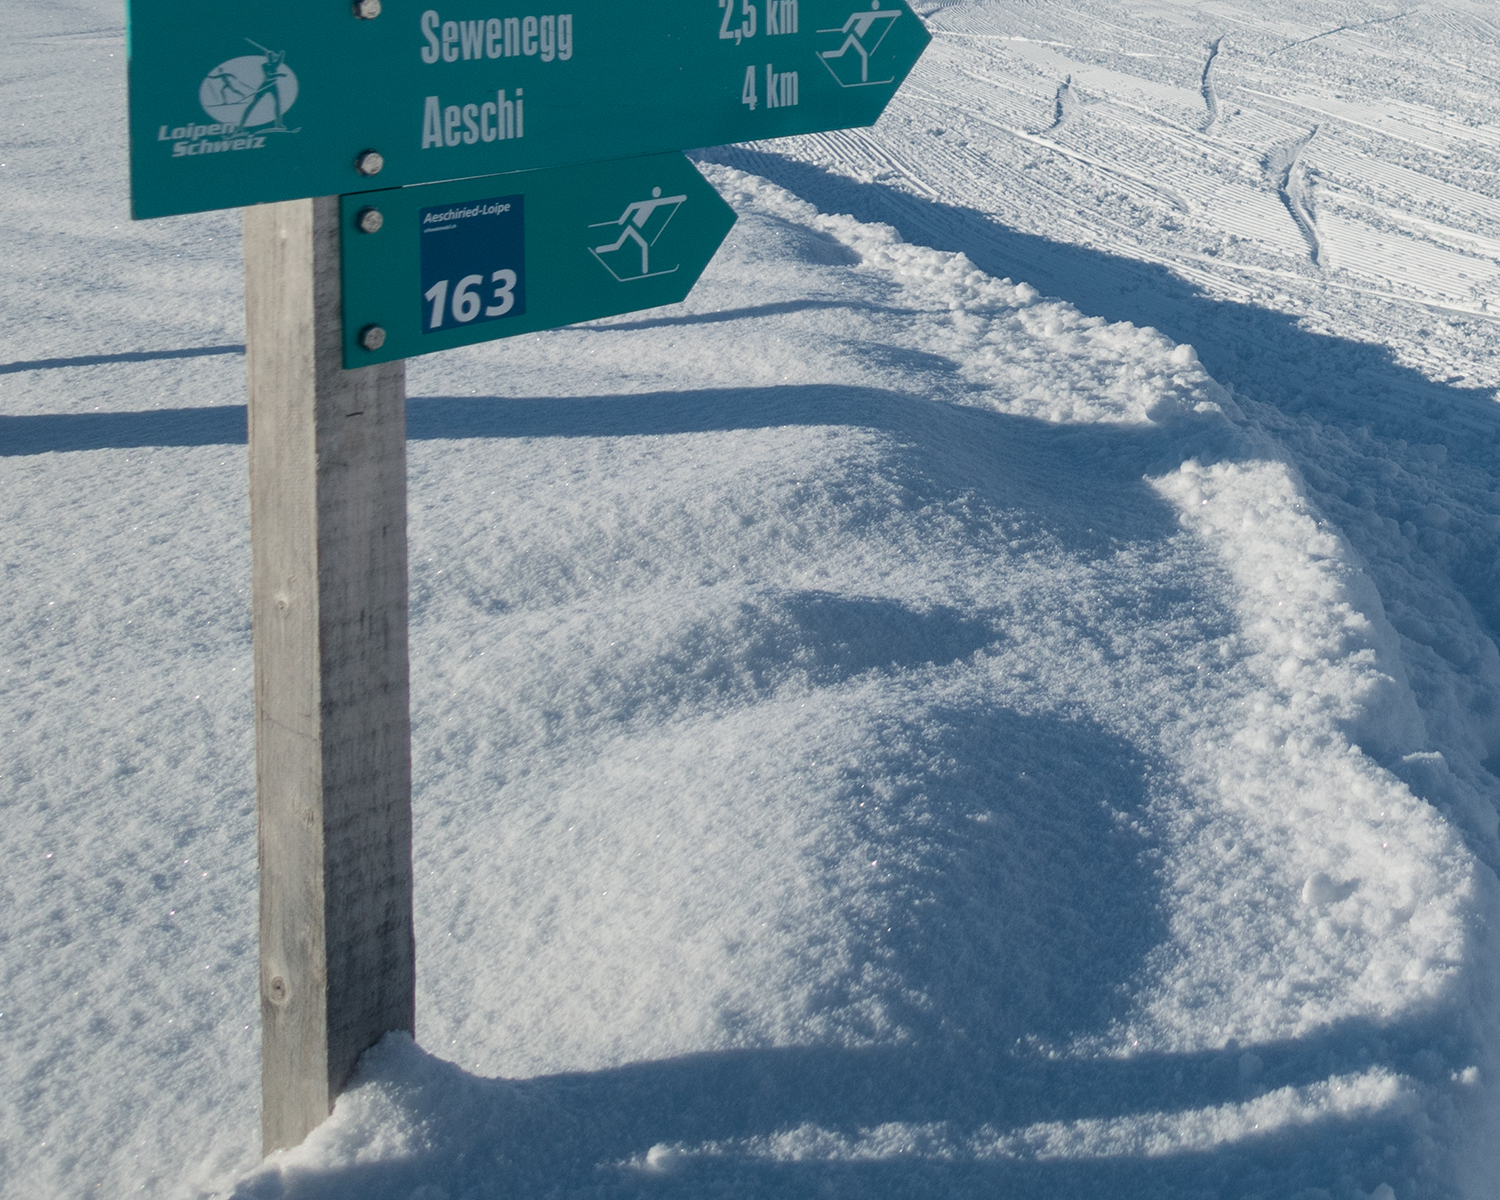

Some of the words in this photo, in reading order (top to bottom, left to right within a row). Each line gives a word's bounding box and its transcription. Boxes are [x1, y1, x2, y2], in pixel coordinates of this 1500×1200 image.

[420, 9, 573, 65] Sewenegg
[421, 88, 524, 150] Aeschi
[741, 64, 757, 111] 4
[766, 63, 799, 109] km
[157, 122, 235, 142] Loipen
[171, 134, 267, 158] Schweiz
[423, 202, 511, 225] Aeschiried-Loipe
[424, 268, 517, 329] 163
